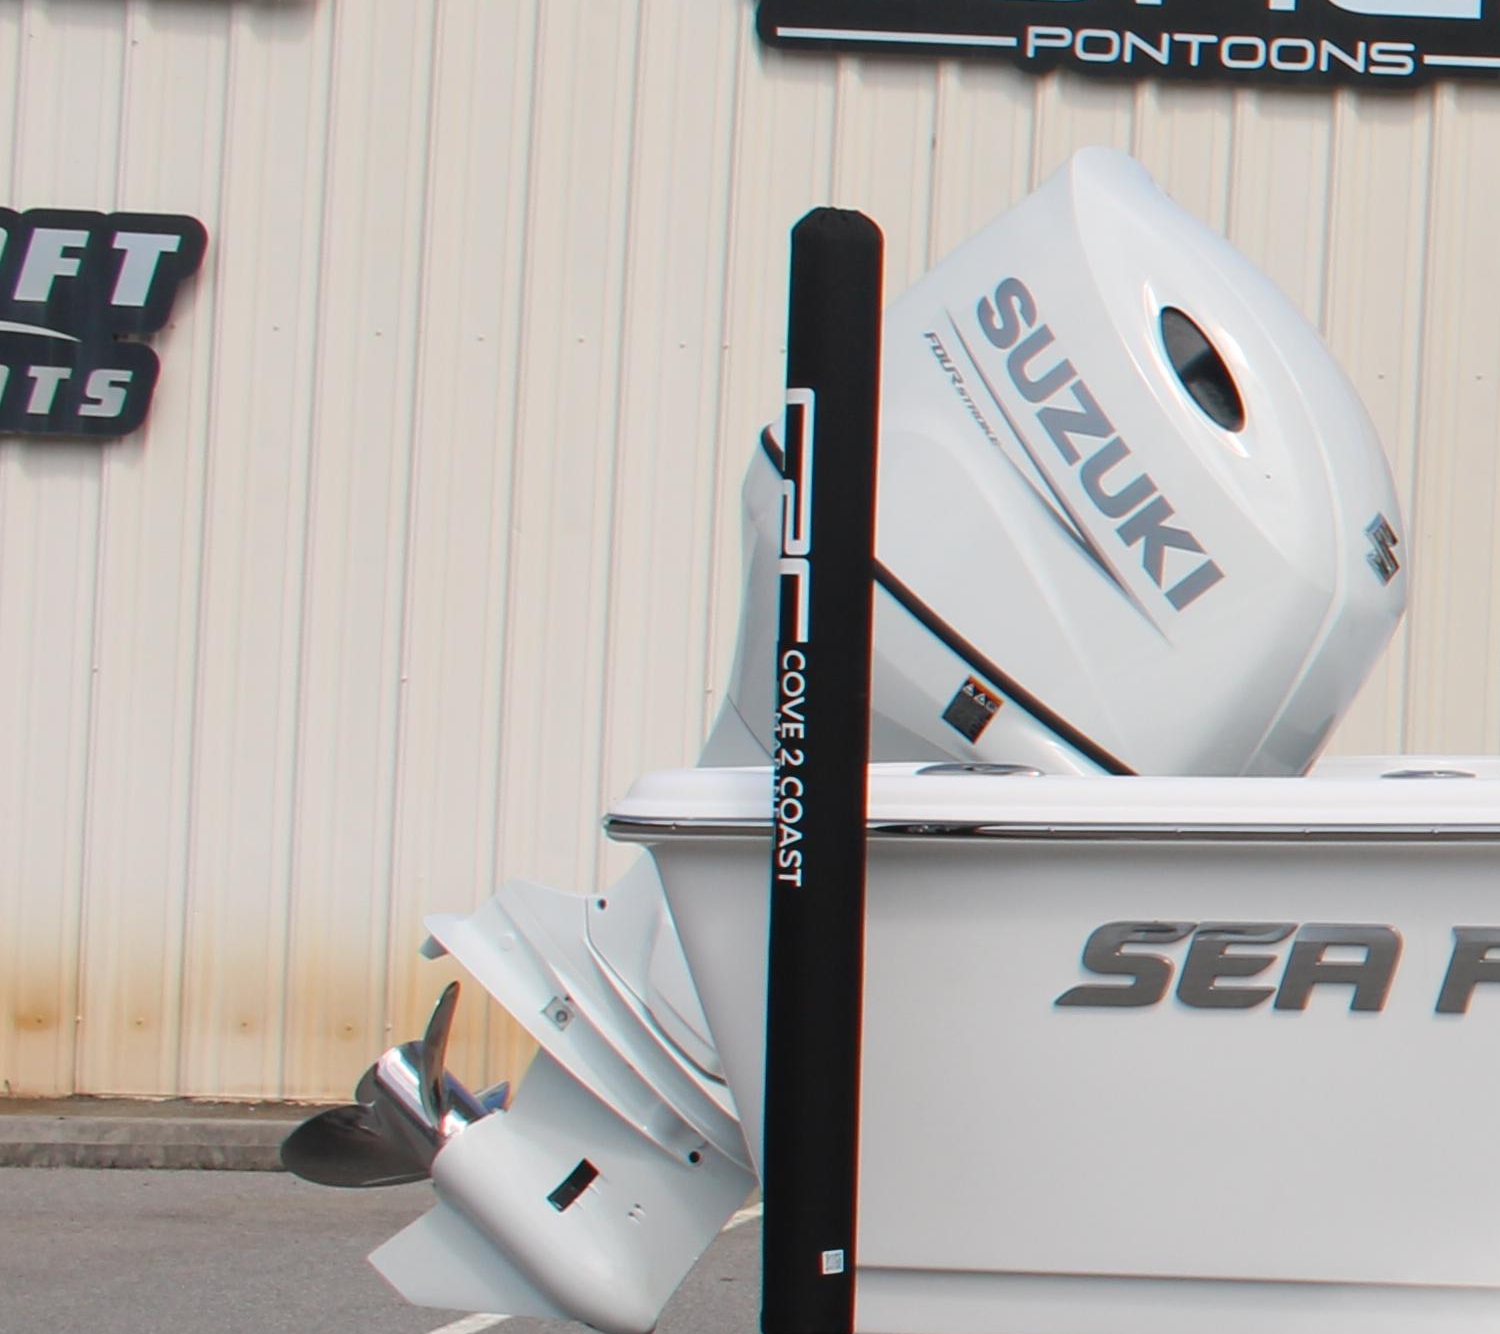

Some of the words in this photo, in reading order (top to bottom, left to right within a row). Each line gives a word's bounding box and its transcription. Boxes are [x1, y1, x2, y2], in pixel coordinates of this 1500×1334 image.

[1026, 26, 1415, 75] PONTOONS
[0, 227, 181, 307] FT
[0, 365, 133, 418] TS
[976, 277, 1225, 612] SUZUKI
[780, 649, 806, 739] COVE
[781, 749, 804, 766] 2
[778, 777, 805, 887] COAST
[1053, 920, 1403, 1014] SEA
